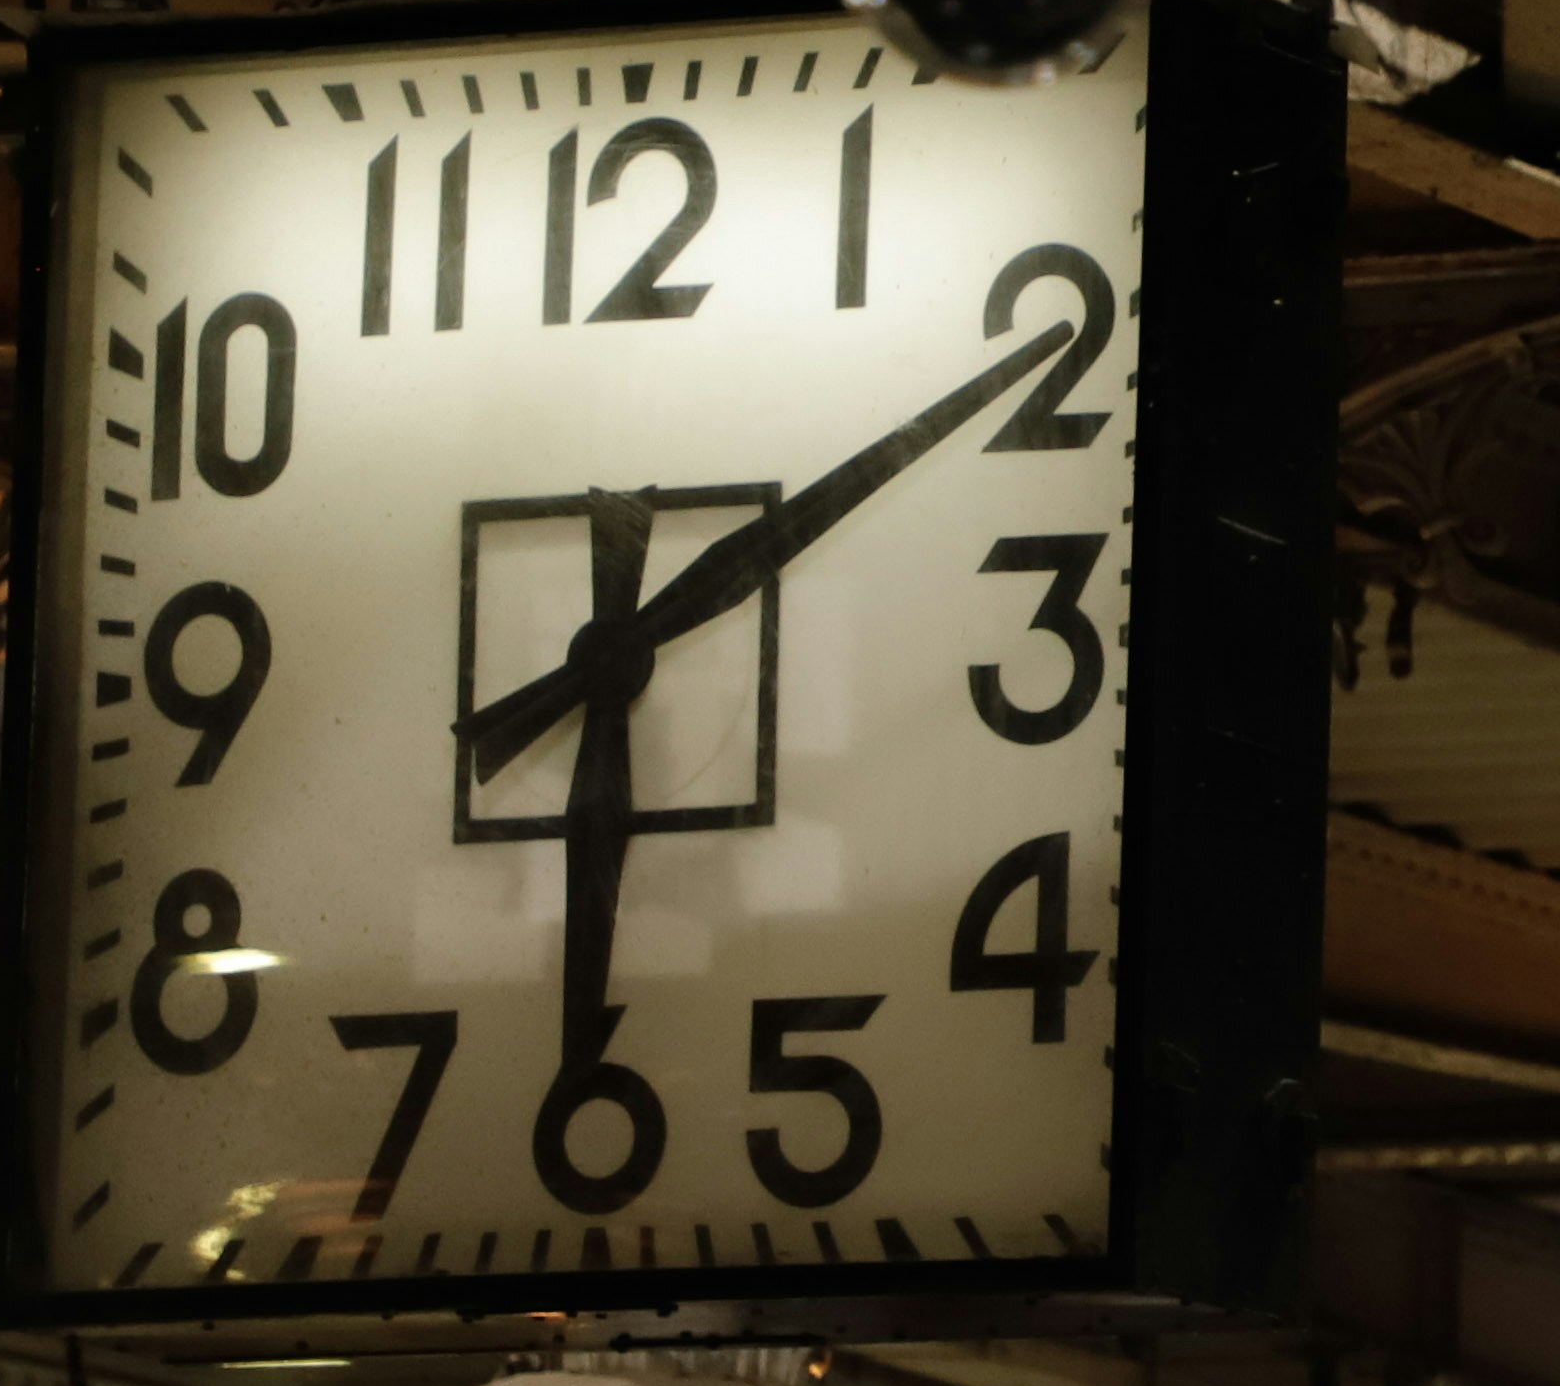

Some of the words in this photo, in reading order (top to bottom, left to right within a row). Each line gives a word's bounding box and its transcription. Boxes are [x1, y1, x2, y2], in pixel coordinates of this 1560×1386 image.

[362, 135, 469, 336] 11
[544, 118, 716, 324] 12
[837, 106, 872, 308] 1
[151, 294, 296, 501] 10
[983, 244, 1115, 452] 2
[144, 581, 271, 788] 9
[968, 533, 1109, 745] 3
[132, 868, 258, 1076] 8
[950, 832, 1100, 1044] 4
[329, 1010, 458, 1220] 7
[533, 1005, 666, 1215] 6
[746, 994, 886, 1209] 5
